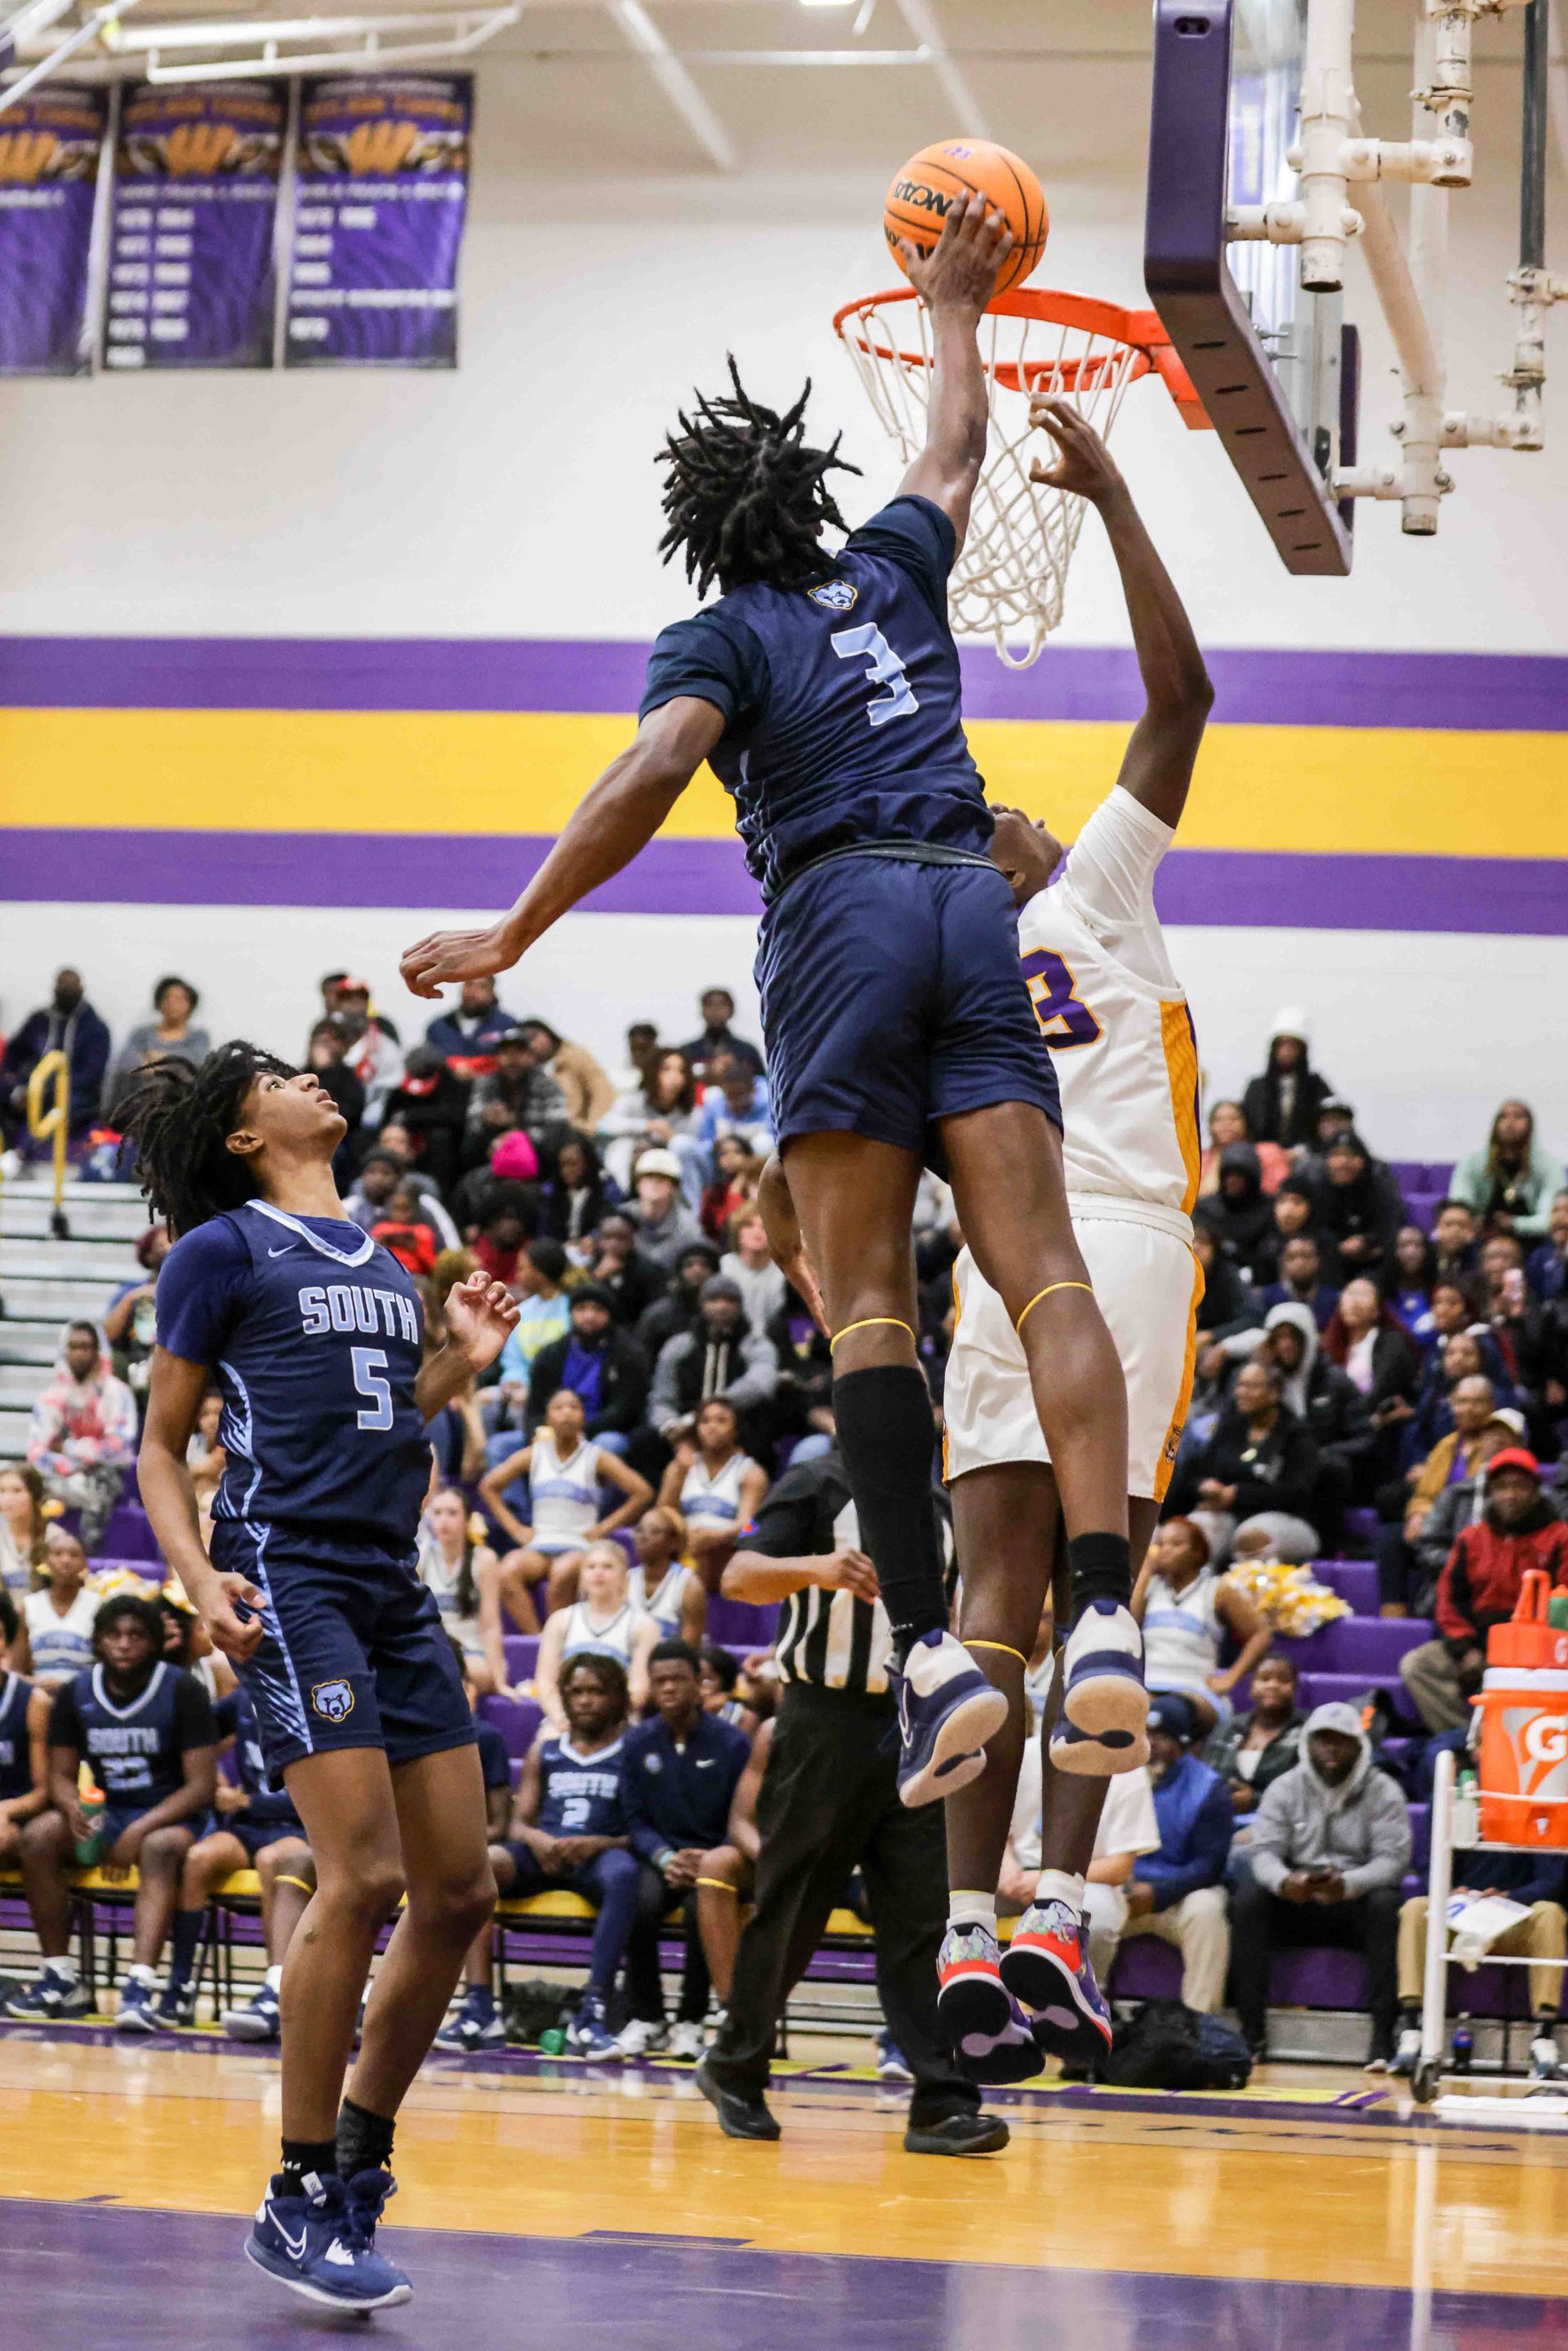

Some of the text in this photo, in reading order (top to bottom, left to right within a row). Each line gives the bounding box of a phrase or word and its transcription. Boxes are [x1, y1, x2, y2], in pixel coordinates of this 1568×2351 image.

[894, 181, 954, 217] NCAA
[831, 622, 920, 726] 3
[298, 1285, 418, 1345] SOUTH
[350, 1346, 394, 1431] 5
[87, 1728, 158, 1754] SOUTH
[1526, 1715, 1567, 1763] G
[548, 1771, 618, 1800] SOUTH
[561, 1797, 590, 1829] 2
